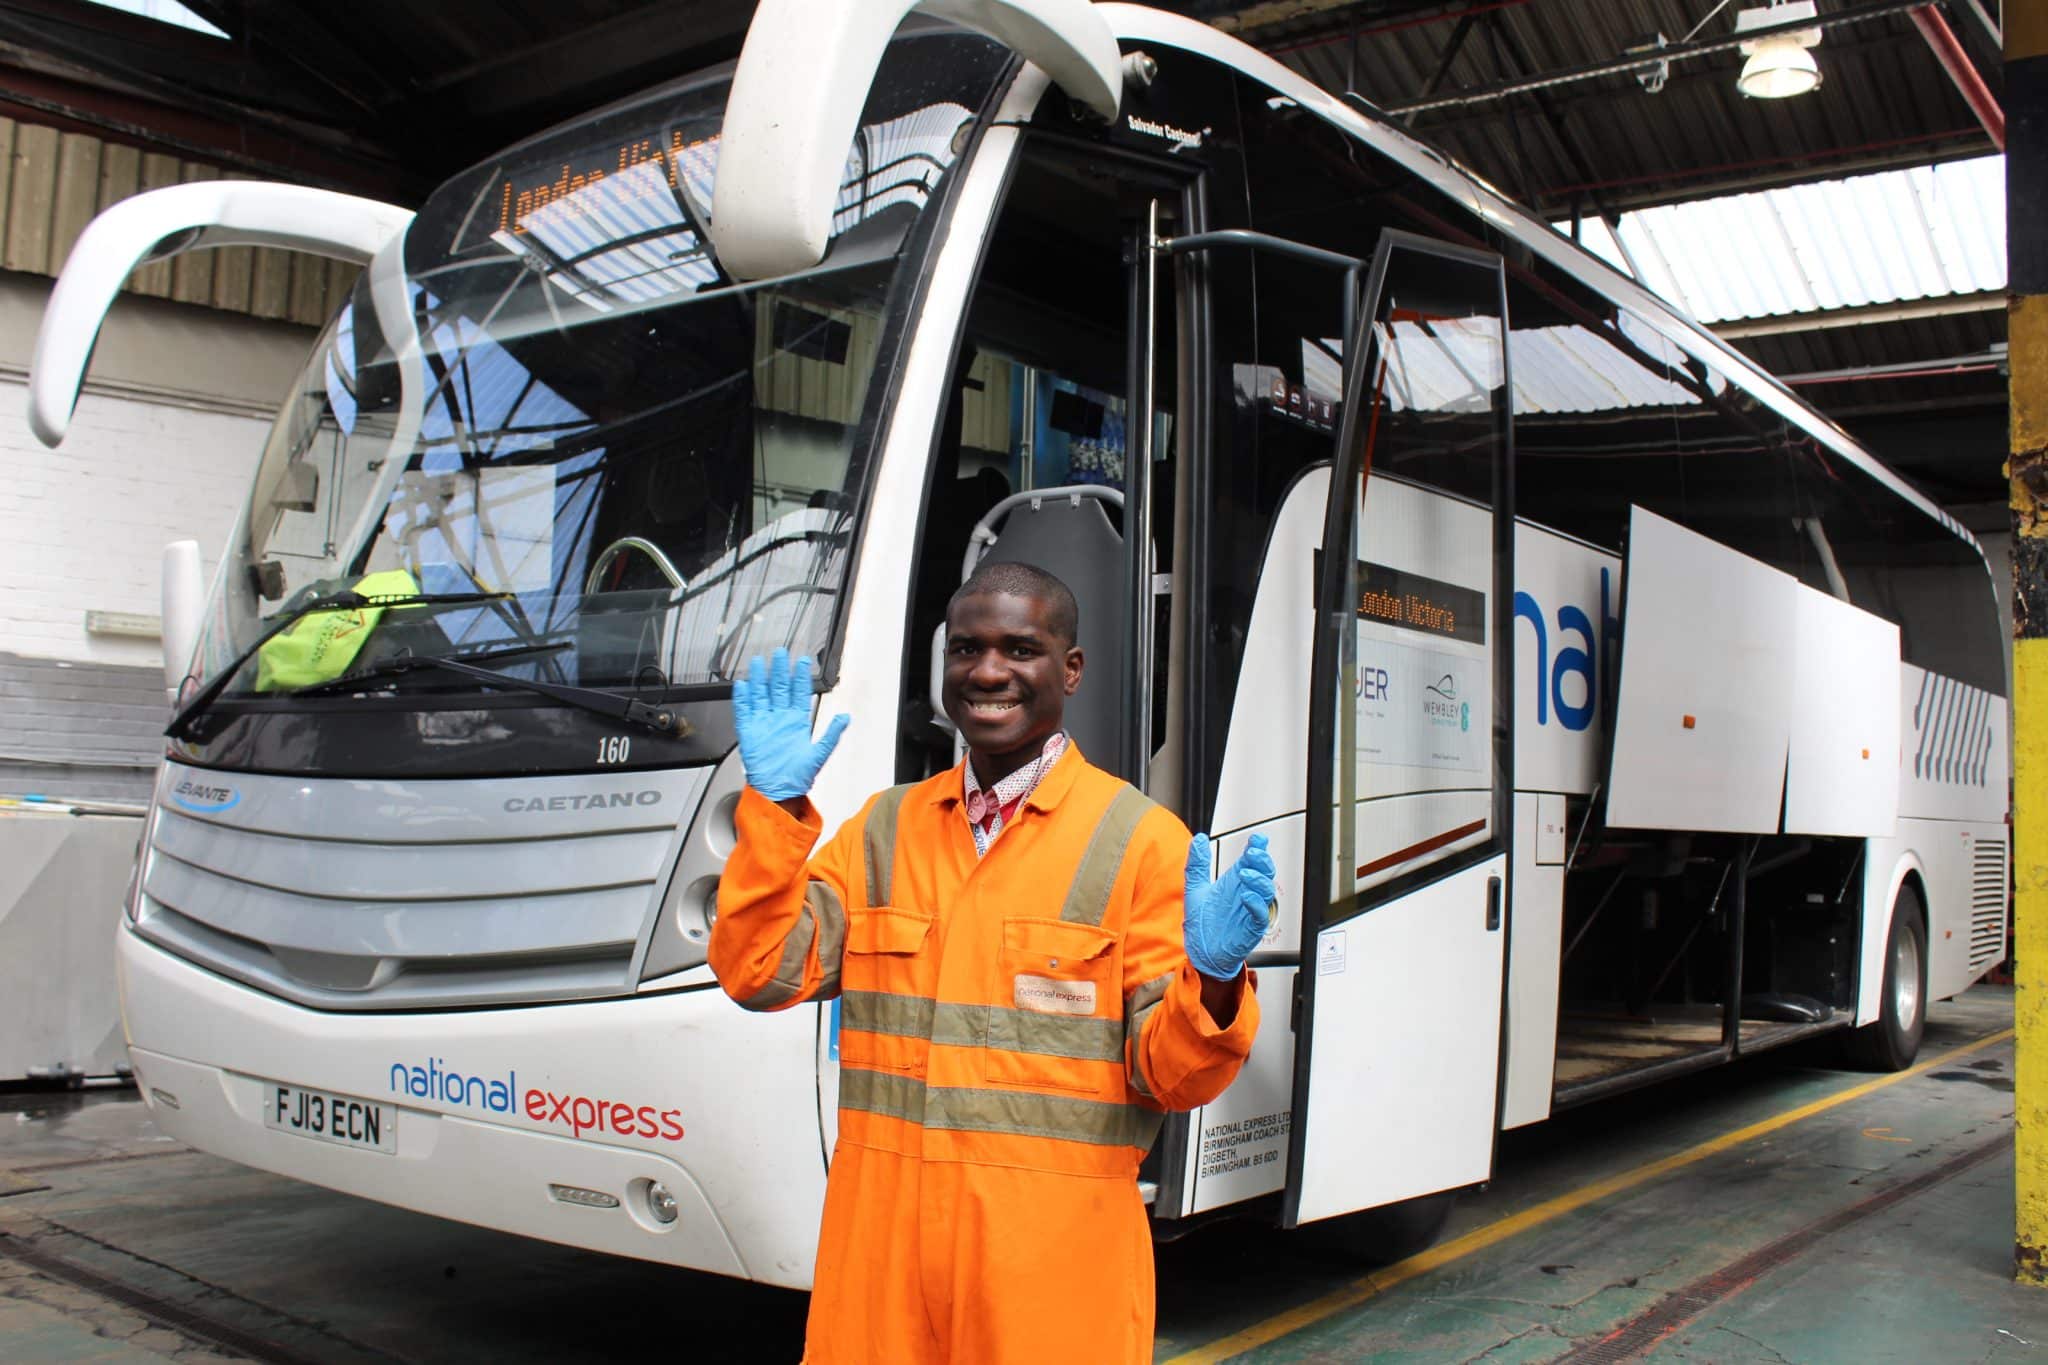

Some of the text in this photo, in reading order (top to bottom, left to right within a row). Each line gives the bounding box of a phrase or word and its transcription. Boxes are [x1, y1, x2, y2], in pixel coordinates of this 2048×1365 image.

[1127, 114, 1164, 138] Salvador
[1404, 593, 1456, 633] Victoria
[1423, 701, 1460, 718] WEMBLEY
[597, 736, 631, 764] 160
[175, 781, 231, 803] LEVANTE
[503, 790, 663, 813] CAETANO
[1018, 987, 1092, 1004] national express
[391, 1057, 685, 1141] national express
[277, 1087, 380, 1145] FJ13 ECN
[1205, 1120, 1242, 1139] NATIONAL
[1243, 1114, 1276, 1131] EXPRESS
[1203, 1131, 1253, 1153] BIRMINGHAM
[1253, 1125, 1279, 1141] COACH
[1253, 1153, 1263, 1167] B5
